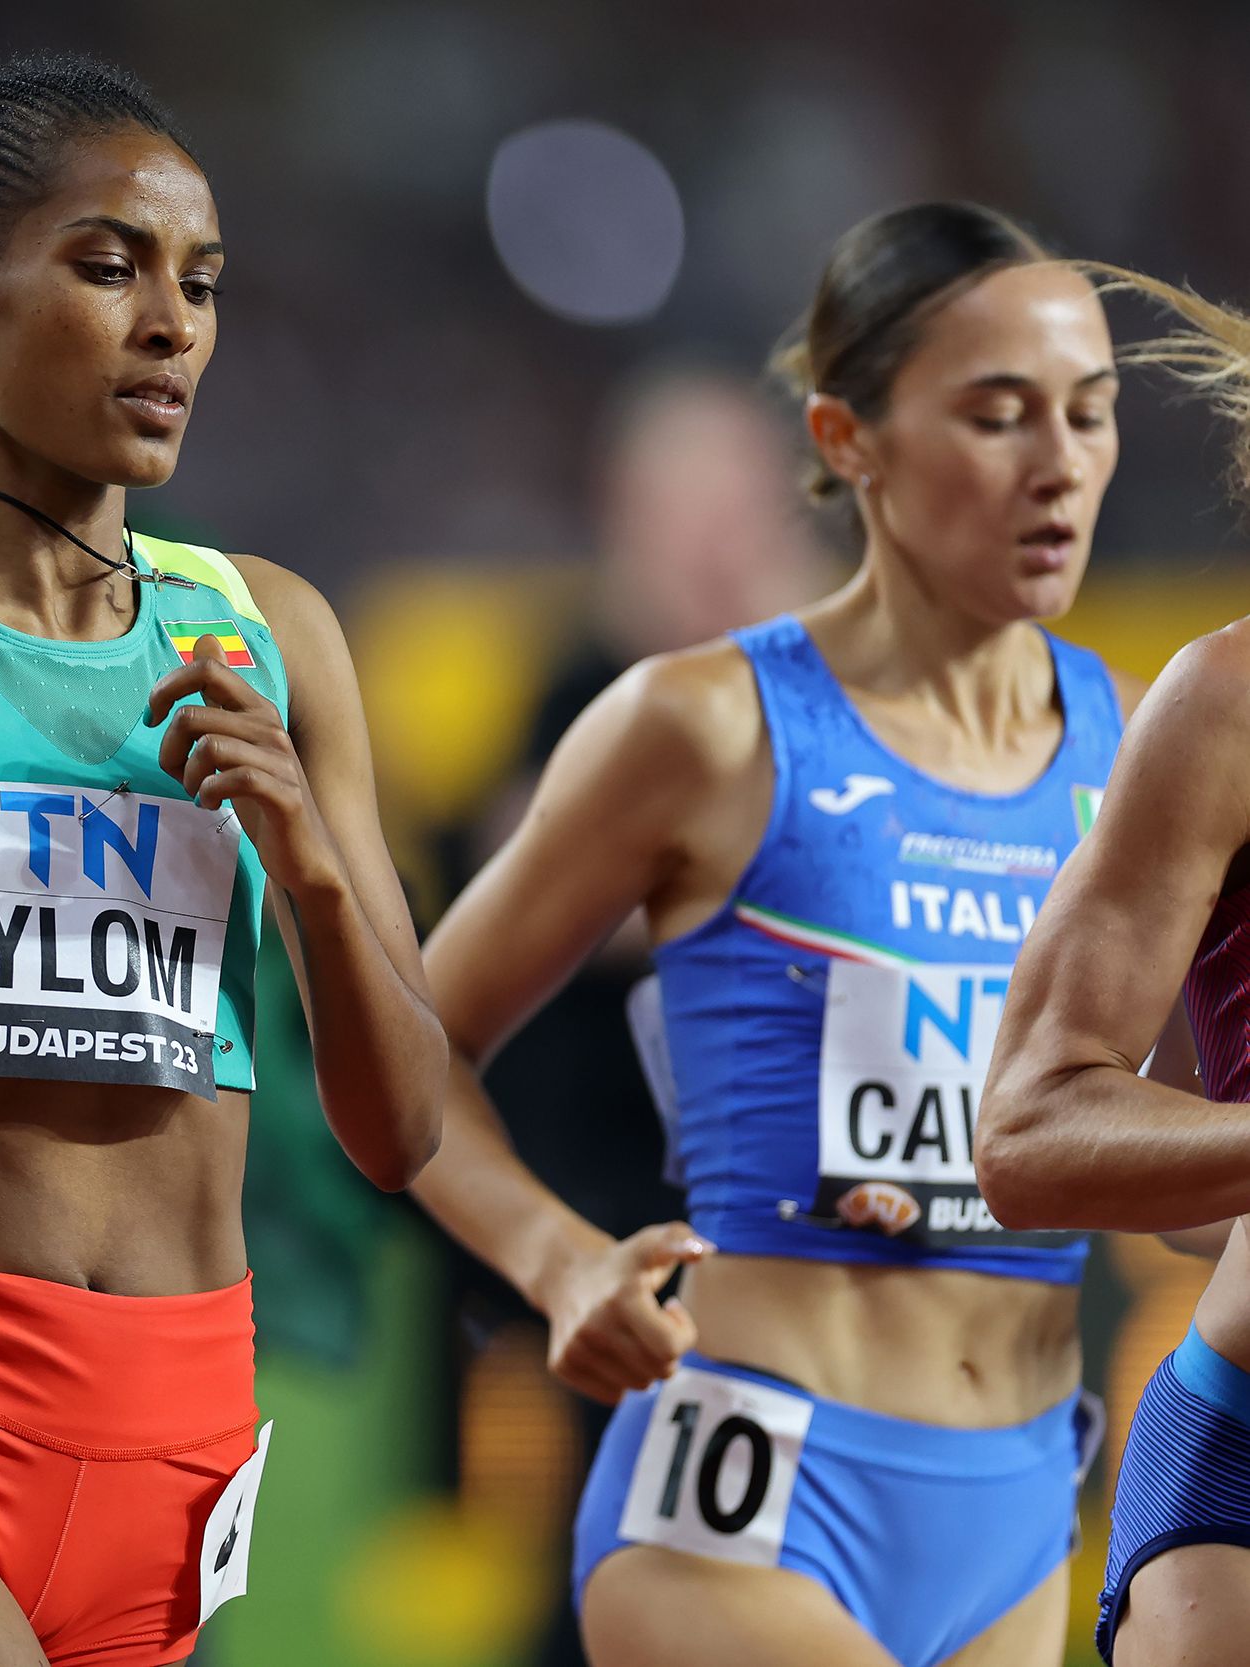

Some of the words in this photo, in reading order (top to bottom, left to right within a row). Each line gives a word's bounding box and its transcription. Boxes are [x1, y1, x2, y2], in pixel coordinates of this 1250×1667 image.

[891, 880, 1037, 943] ITALI
[170, 1040, 199, 1075] 23
[928, 1197, 1005, 1232] BUD
[658, 1402, 772, 1535] 10
